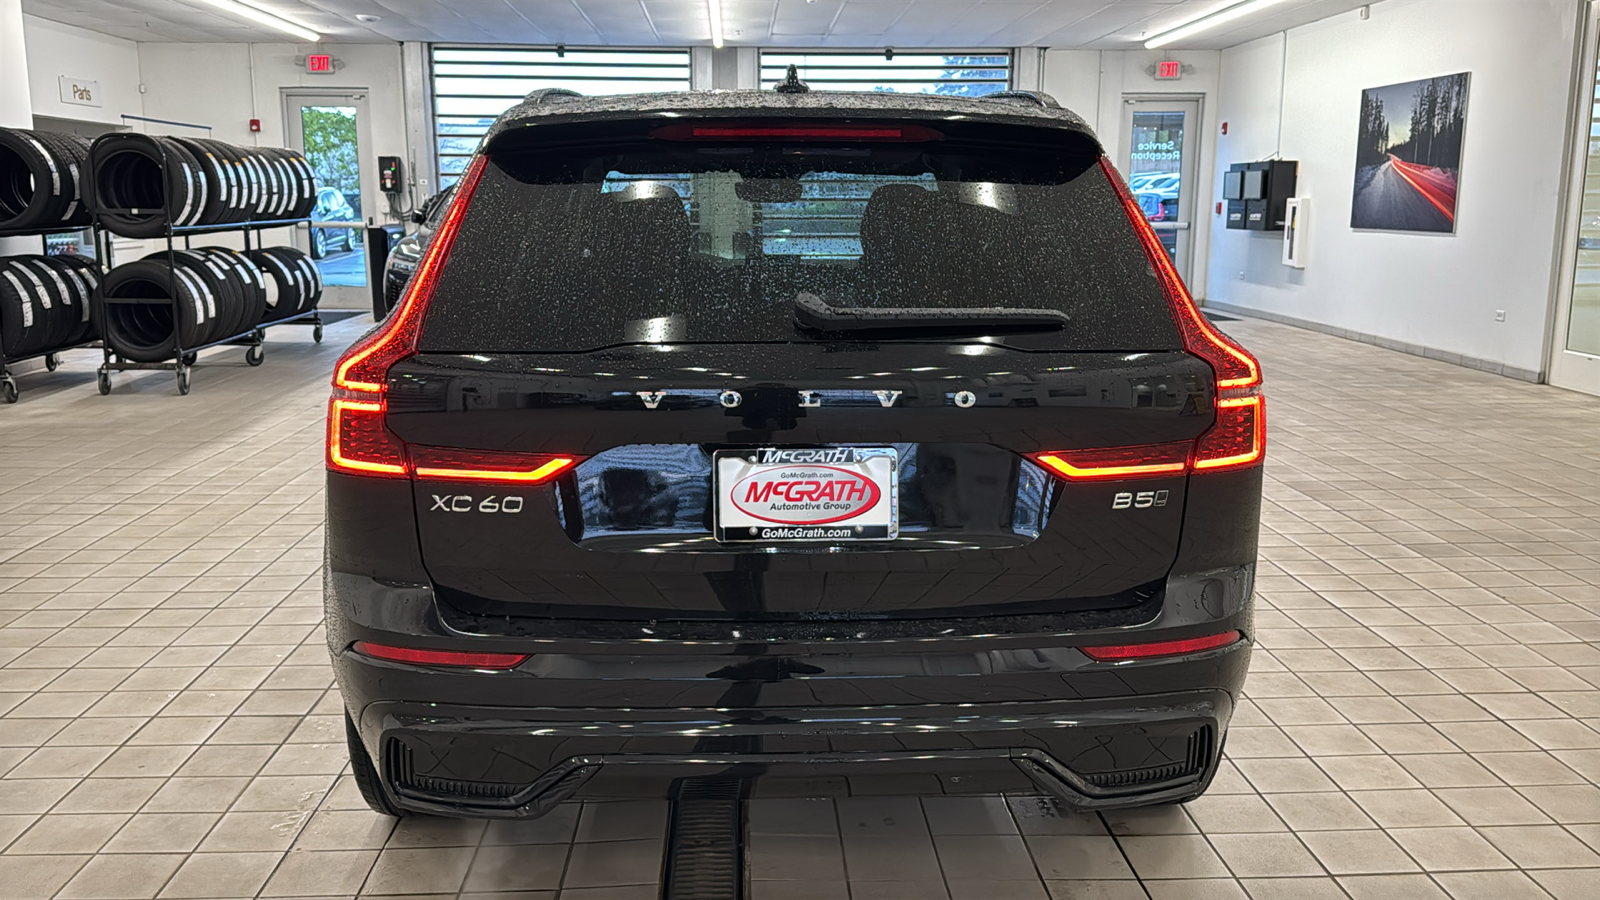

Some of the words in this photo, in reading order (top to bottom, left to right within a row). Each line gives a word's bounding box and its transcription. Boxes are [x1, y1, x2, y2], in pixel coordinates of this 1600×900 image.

[309, 54, 330, 71] EXIT
[1159, 61, 1179, 77] EXIT
[72, 84, 92, 101] Parts
[780, 471, 834, 479] GoMcGrath.com
[769, 502, 821, 511] Automotive
[822, 501, 852, 512] Group
[1111, 491, 1155, 509] B5
[761, 527, 851, 539] GoMcGrath.com
